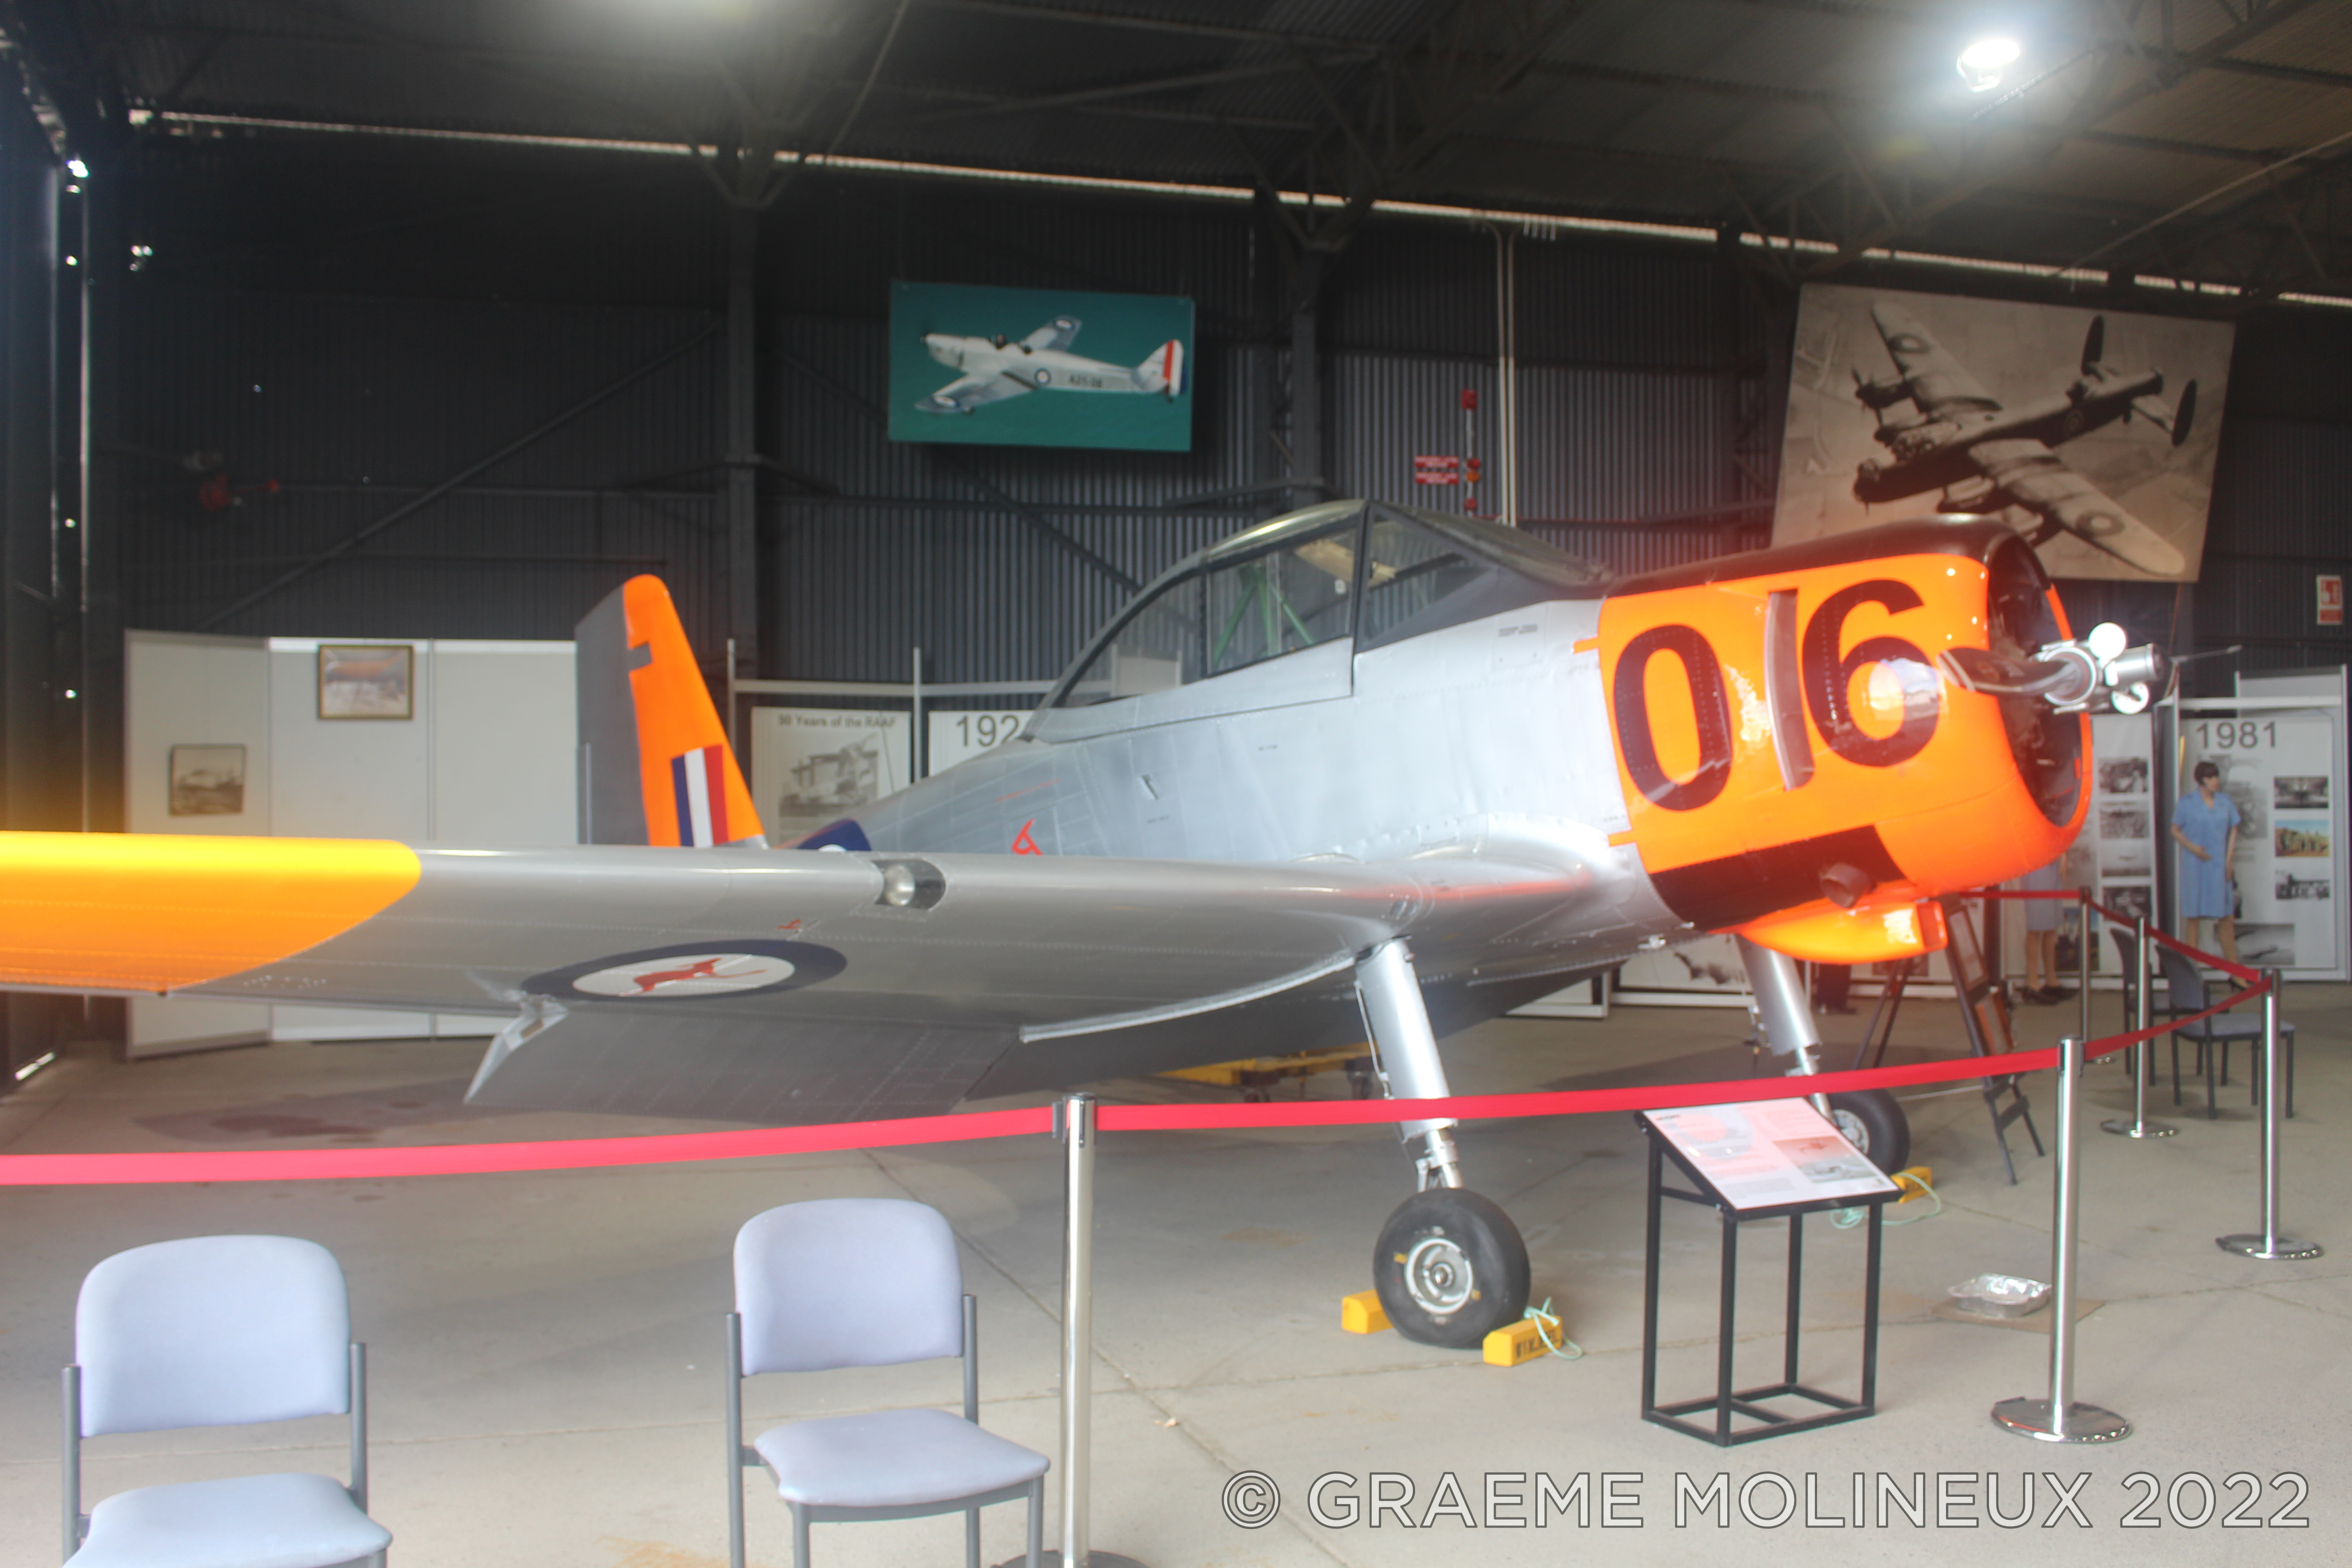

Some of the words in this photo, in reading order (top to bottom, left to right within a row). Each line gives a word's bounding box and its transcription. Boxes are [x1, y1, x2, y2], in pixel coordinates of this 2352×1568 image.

[1613, 578, 1940, 811] 06
[795, 714, 827, 726] Years
[830, 715, 842, 726] of
[844, 716, 862, 726] the
[865, 716, 896, 727] RAAF
[2196, 721, 2277, 748] 1981
